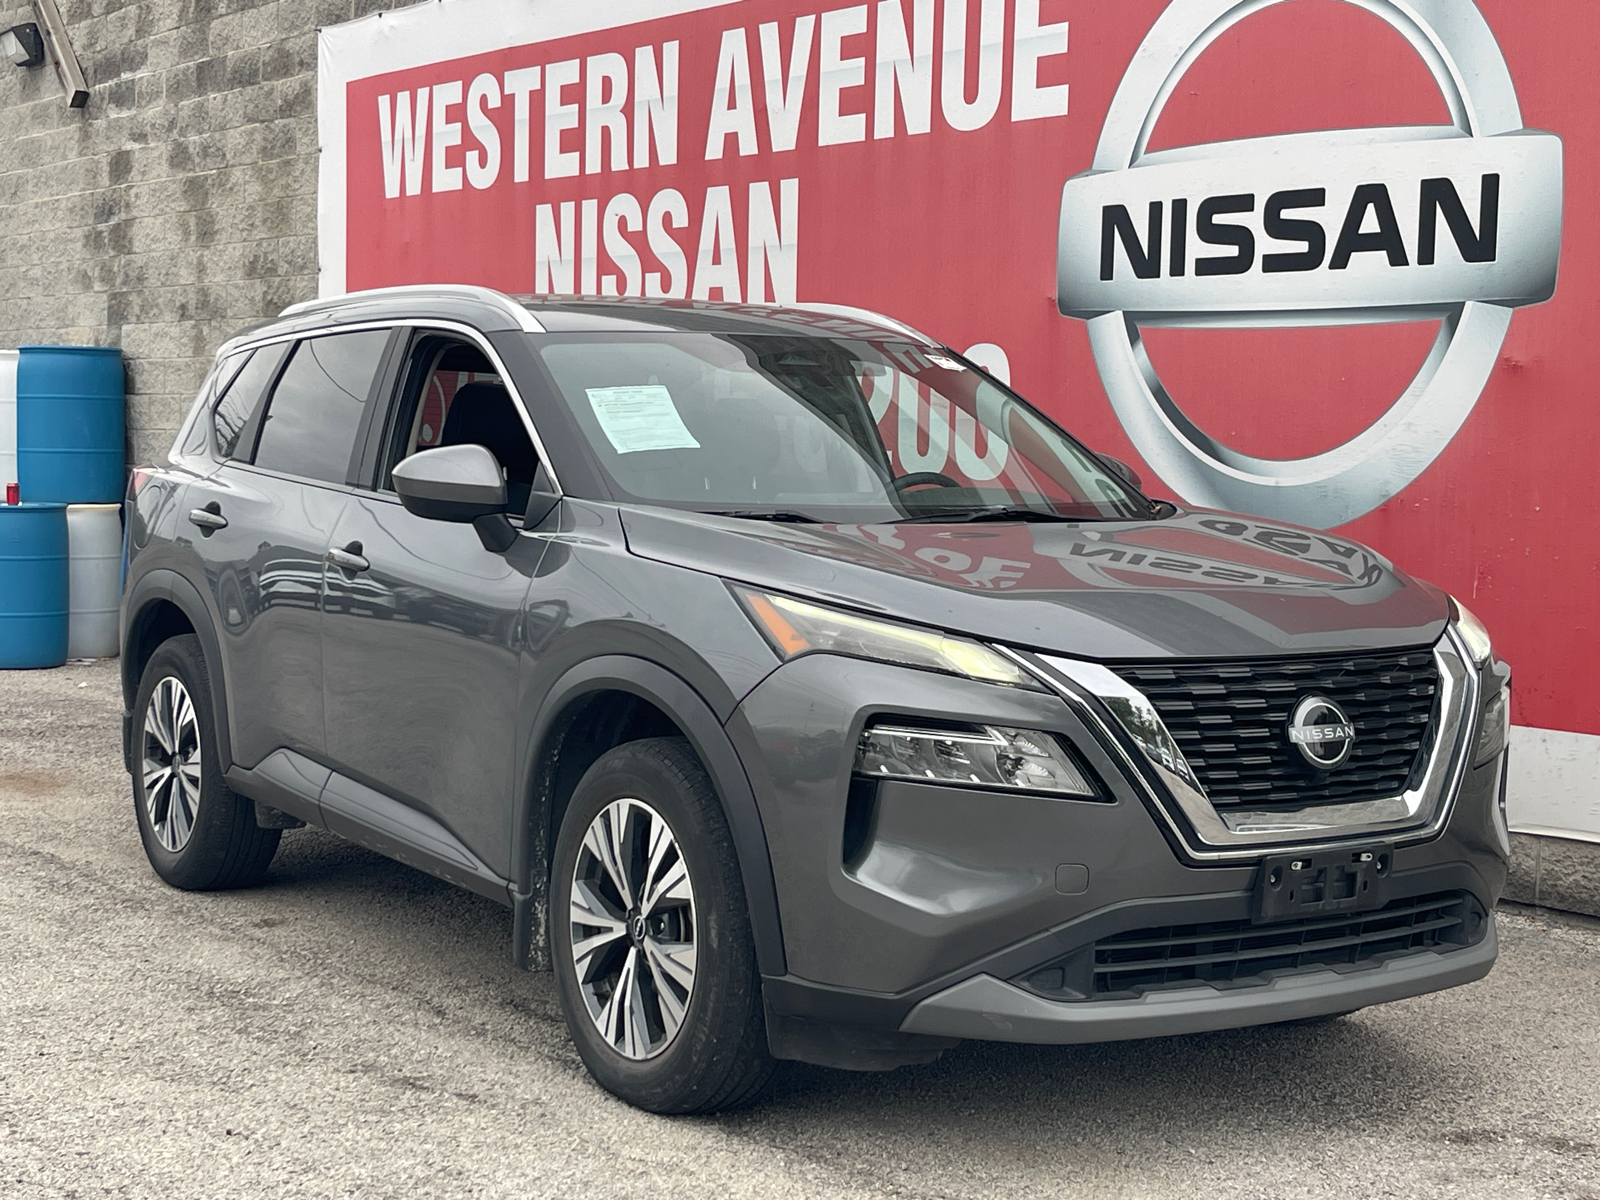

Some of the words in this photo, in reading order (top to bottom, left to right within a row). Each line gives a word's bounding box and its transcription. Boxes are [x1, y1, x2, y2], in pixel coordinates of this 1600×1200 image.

[377, 40, 680, 200] WESTERN
[705, 0, 1069, 161] AVENUE
[535, 178, 799, 304] NISSAN
[1100, 173, 1500, 281] NISSAN
[1291, 725, 1354, 742] NISSAN
